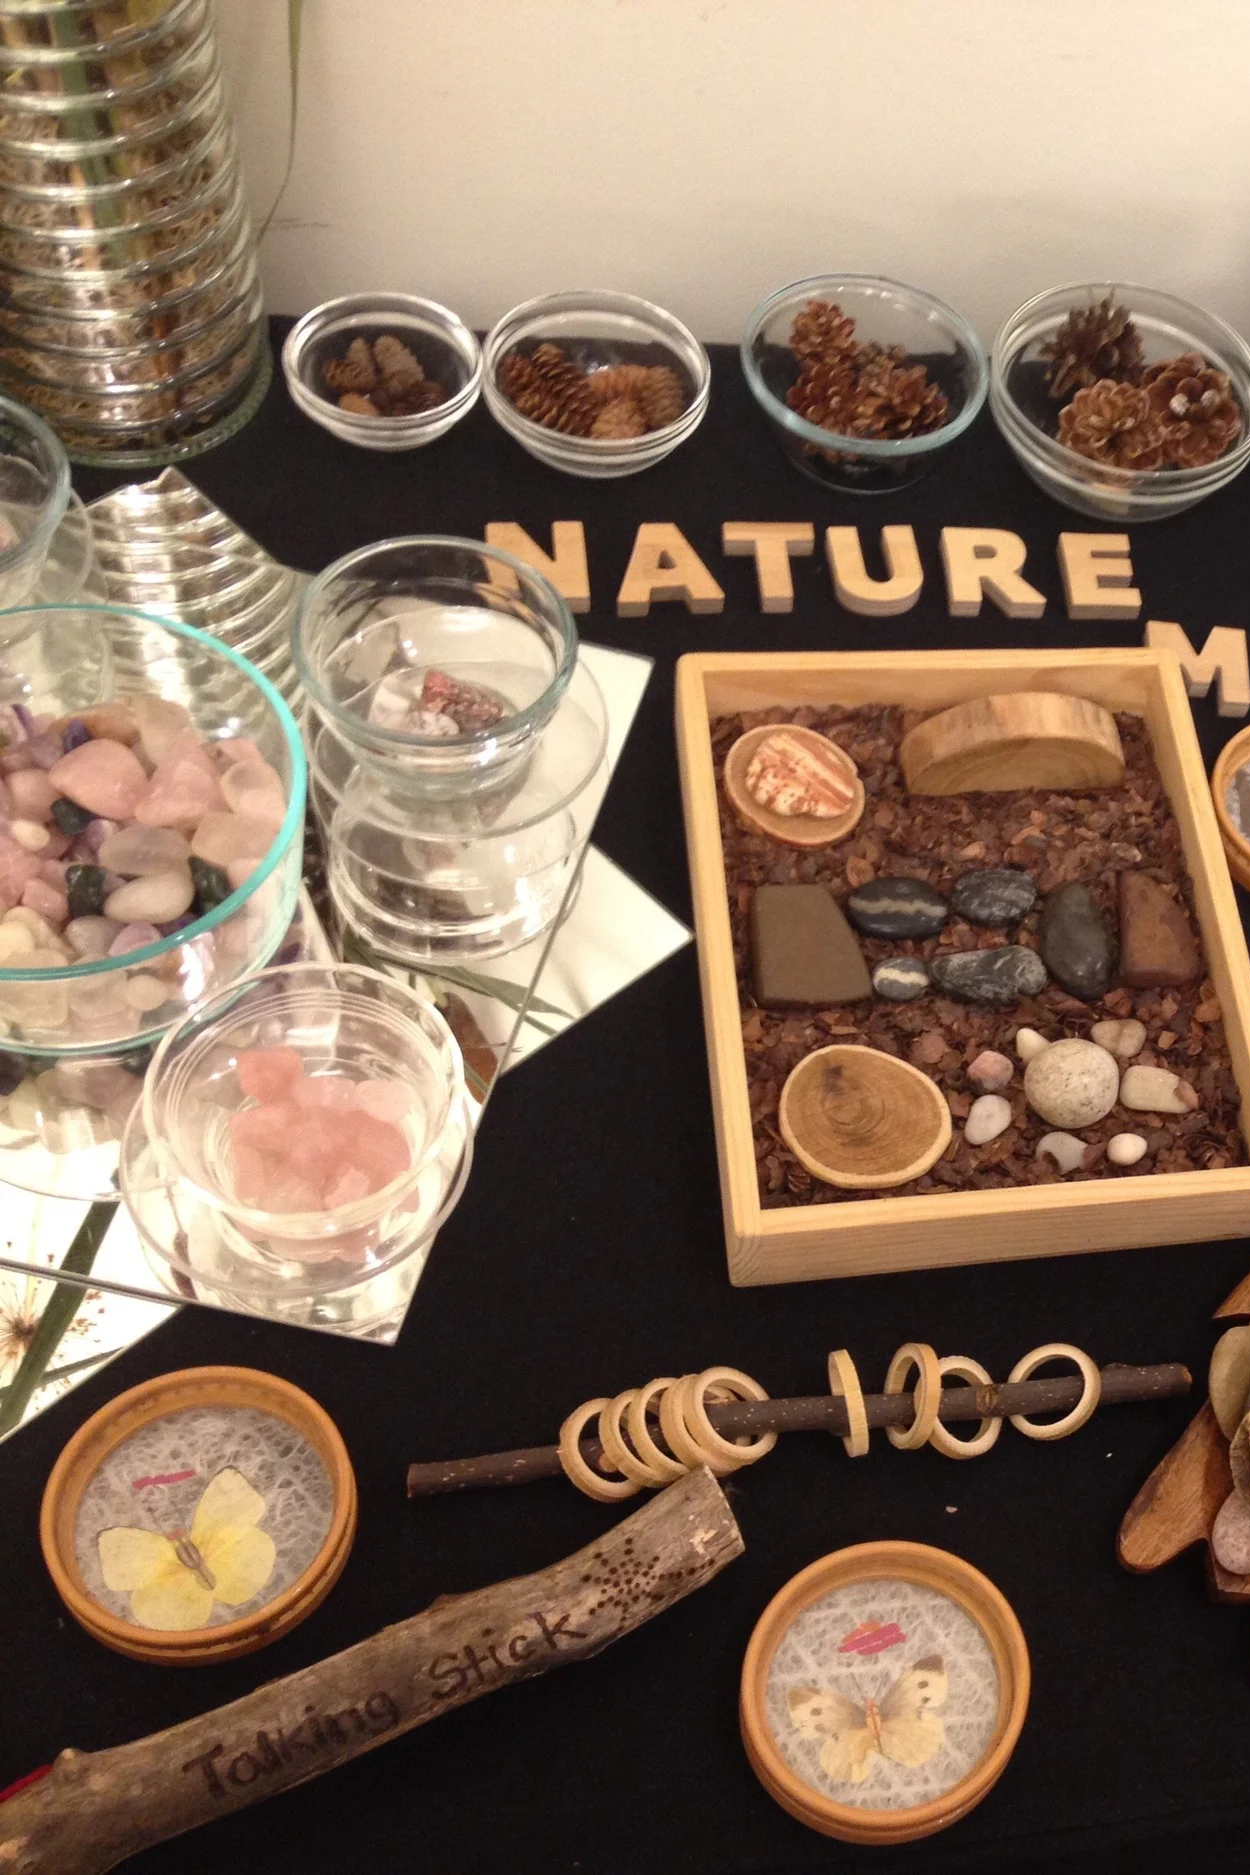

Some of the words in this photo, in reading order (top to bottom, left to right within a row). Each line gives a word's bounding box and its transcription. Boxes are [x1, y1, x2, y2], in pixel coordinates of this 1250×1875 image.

[484, 520, 1142, 619] NATURE
[182, 1690, 399, 1799] Talking
[427, 1611, 588, 1700] Stick
